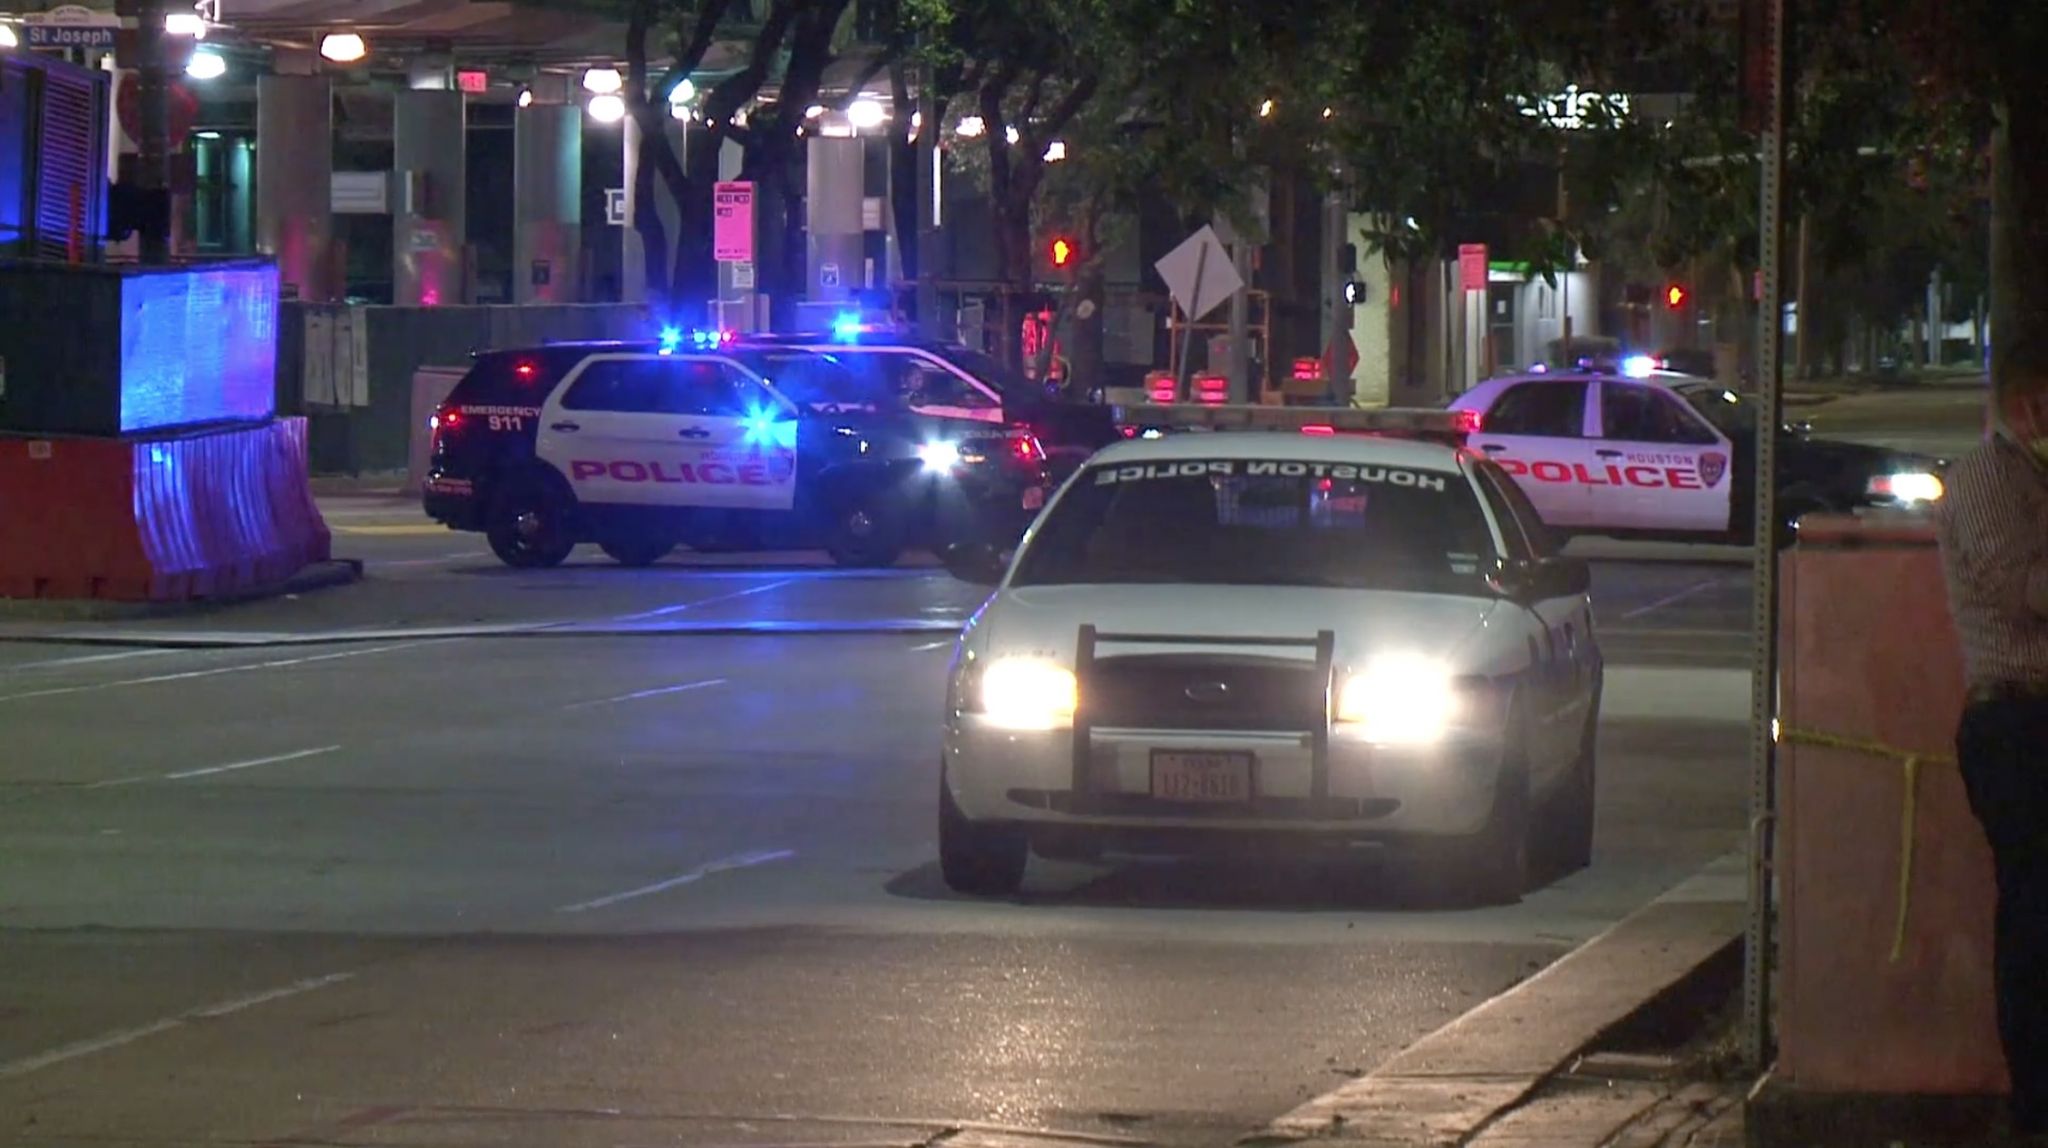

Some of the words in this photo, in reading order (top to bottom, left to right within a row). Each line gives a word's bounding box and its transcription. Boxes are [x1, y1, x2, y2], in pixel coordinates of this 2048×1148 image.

[30, 27, 47, 42] St
[51, 27, 112, 44] Joseph
[461, 404, 541, 417] EMERGENCY
[488, 415, 522, 431] 911
[1627, 453, 1693, 466] HOUSTON
[570, 460, 773, 486] POLICE
[1496, 459, 1702, 489] POLICE
